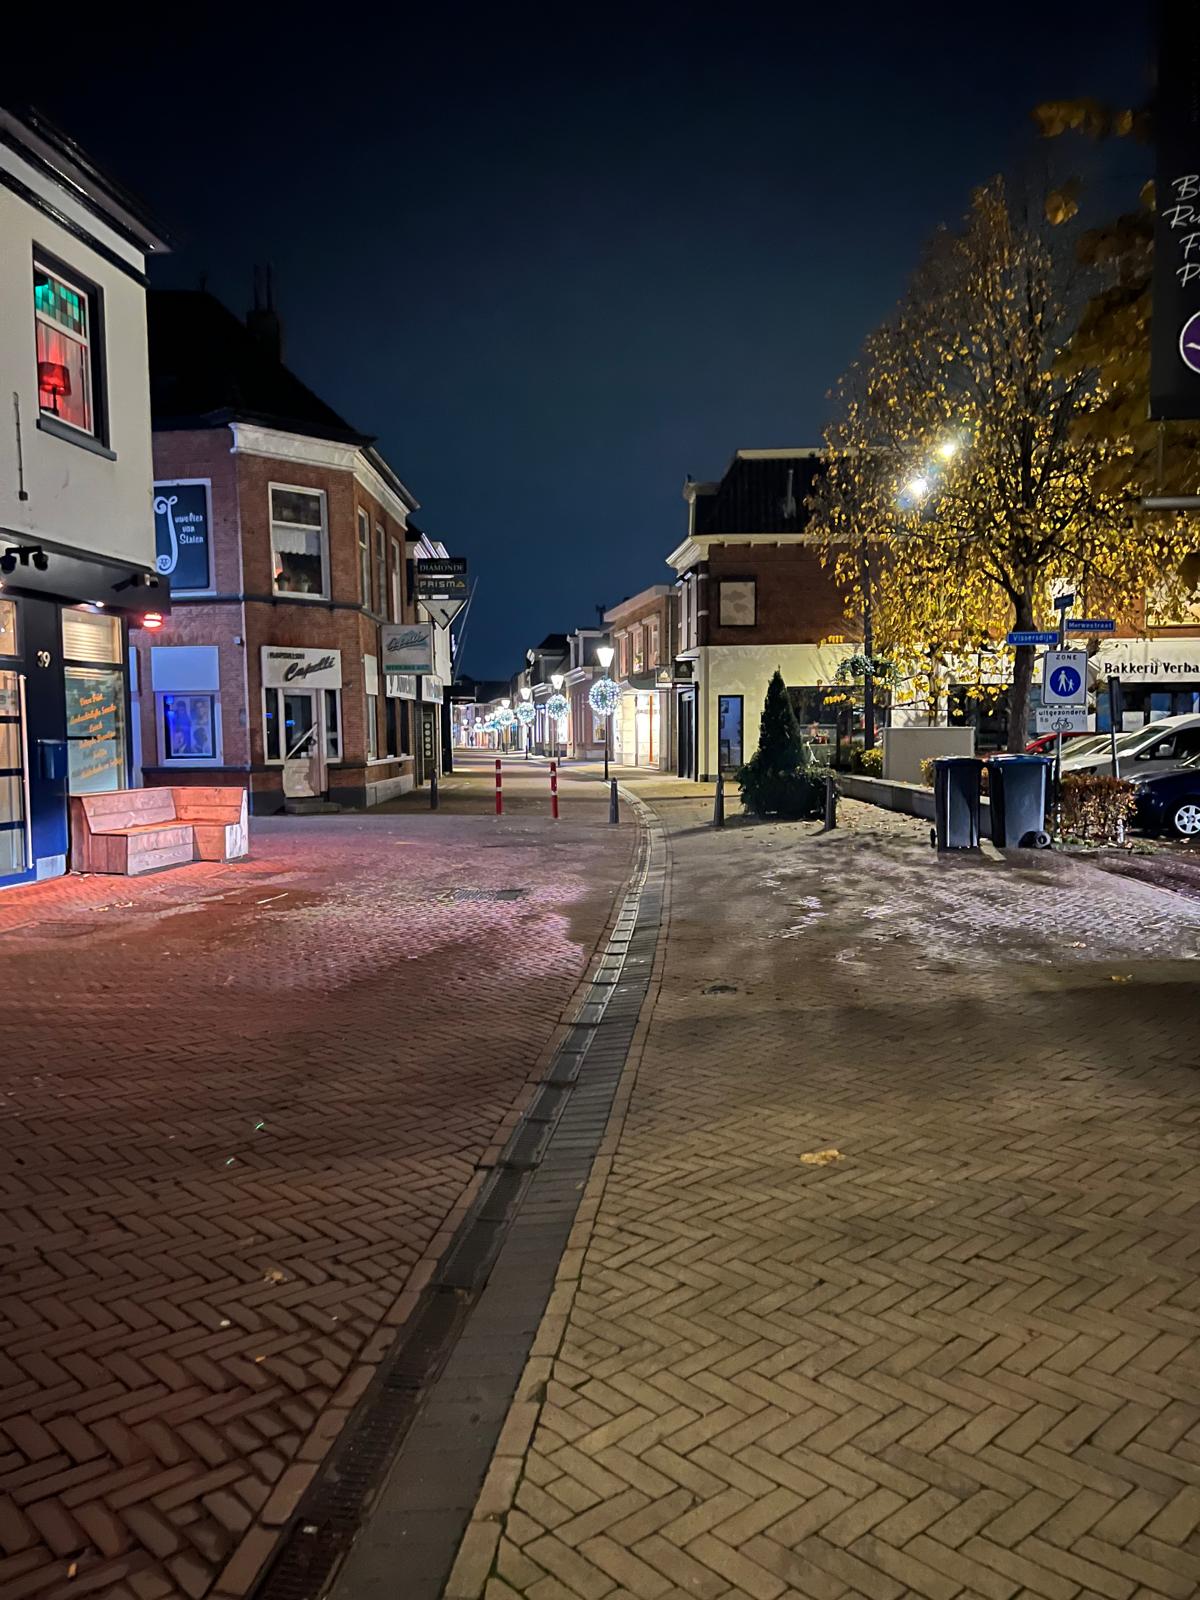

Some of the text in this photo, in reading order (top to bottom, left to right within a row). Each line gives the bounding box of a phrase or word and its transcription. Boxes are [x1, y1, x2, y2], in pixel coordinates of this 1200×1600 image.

[1171, 175, 1200, 201] B
[1179, 232, 1200, 259] F
[1176, 262, 1200, 288] P
[37, 651, 51, 668] 39
[284, 655, 335, 682] Capelli
[1104, 662, 1158, 675] Bakkerij
